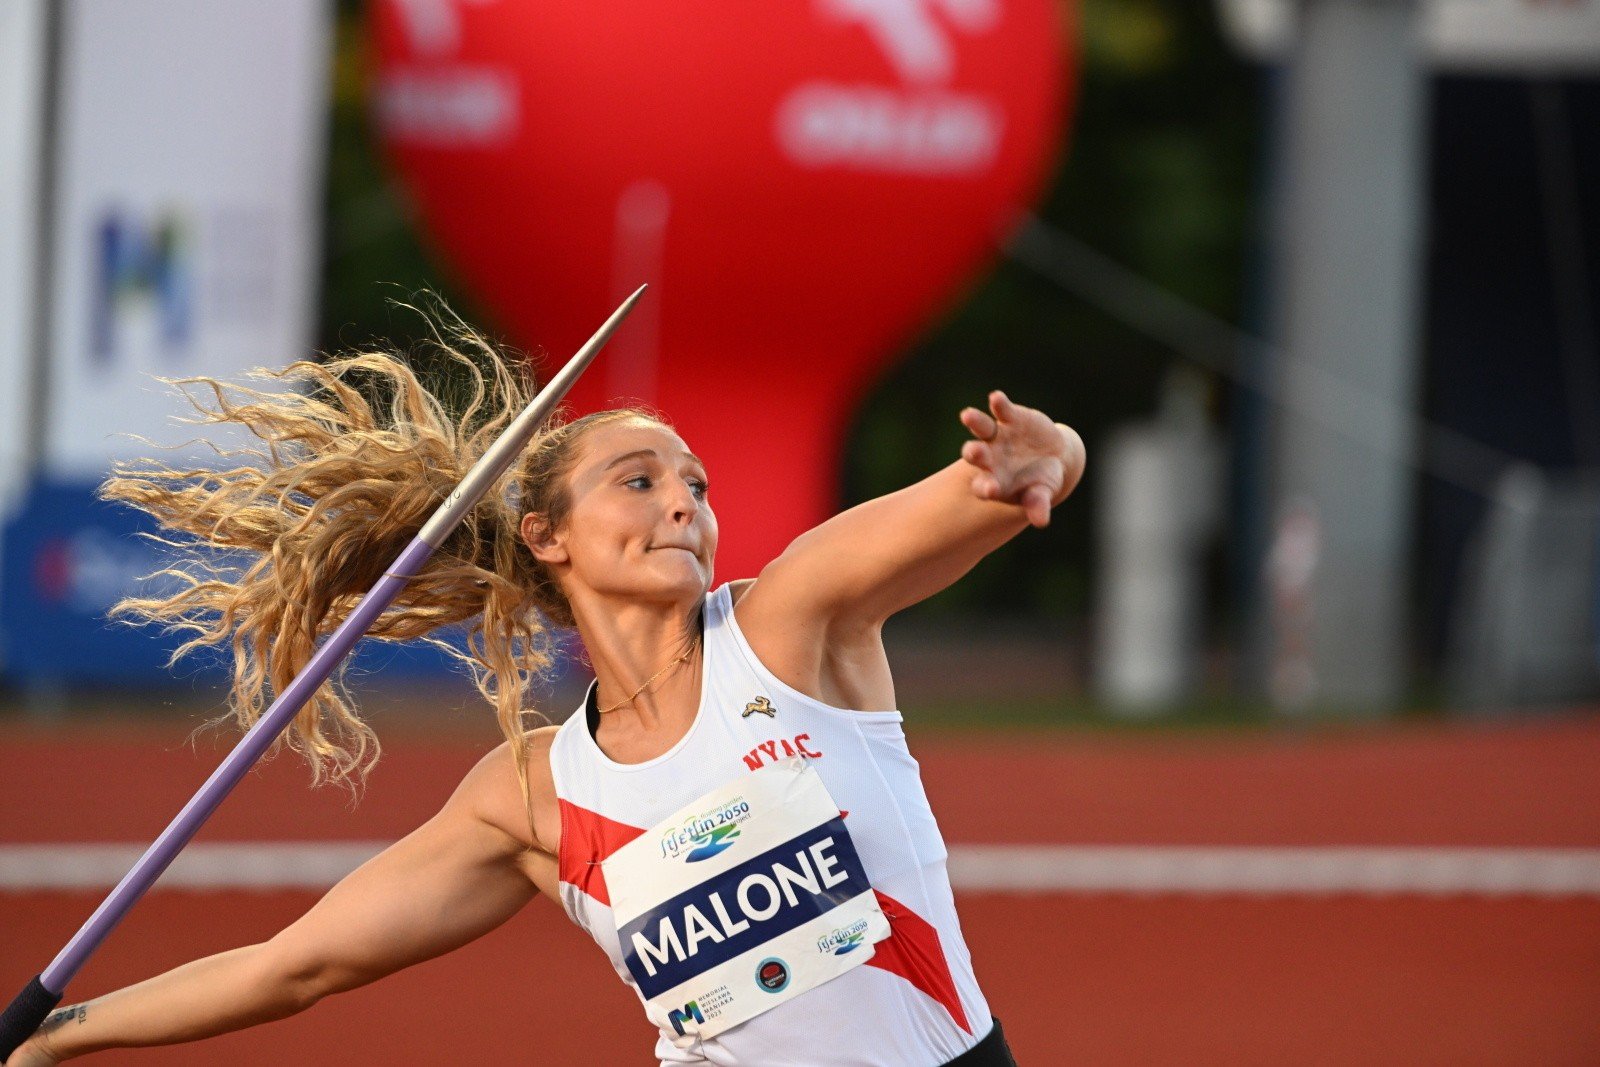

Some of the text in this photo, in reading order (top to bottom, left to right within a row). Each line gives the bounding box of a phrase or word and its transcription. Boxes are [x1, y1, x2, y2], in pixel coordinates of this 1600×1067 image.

[717, 801, 749, 825] 2050
[631, 836, 849, 977] MALONE
[704, 996, 734, 1014] MANIAKA
